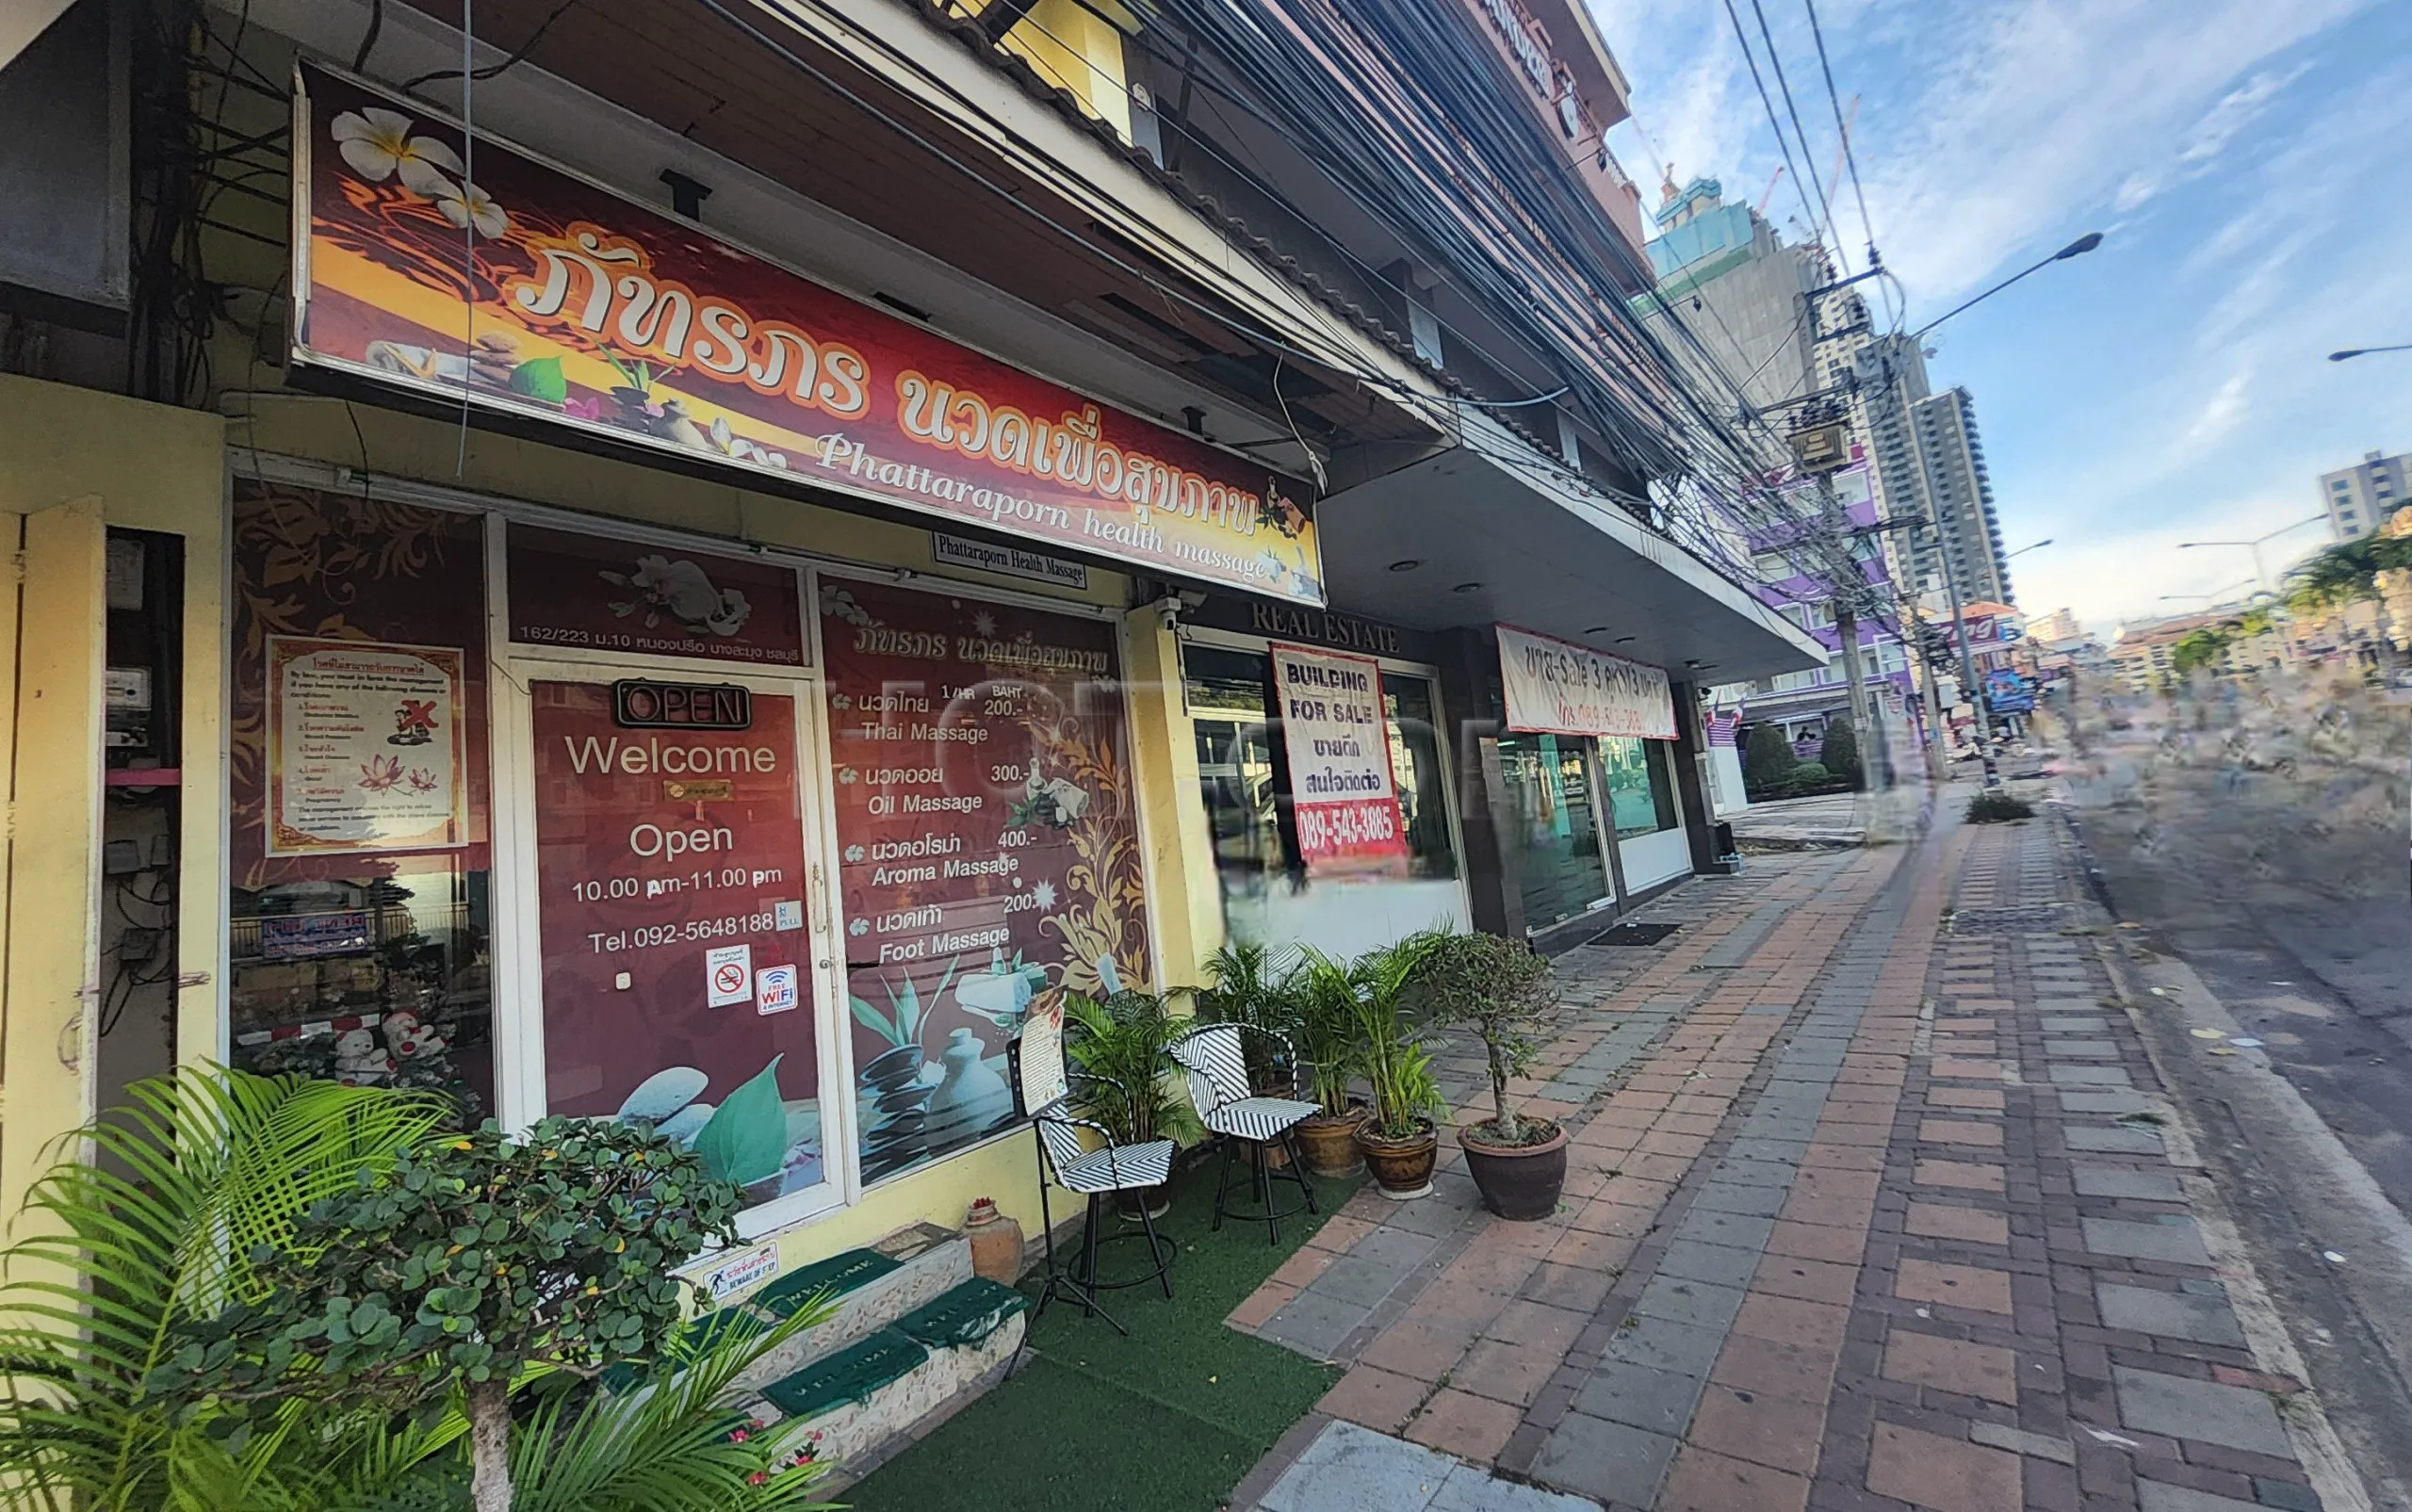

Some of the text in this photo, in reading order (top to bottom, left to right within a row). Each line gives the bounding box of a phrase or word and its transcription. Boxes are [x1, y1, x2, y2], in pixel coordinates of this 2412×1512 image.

[513, 230, 1258, 539] ภัทรภร นวดเพื่อสุขภาพ
[814, 432, 1268, 582] Phattaraporn health massage
[937, 534, 1083, 585] Phattaraporn Health Massage
[519, 626, 589, 643] 162/223
[854, 620, 947, 658] ภัทรภร
[1252, 602, 1400, 654] REAL ESTATE
[627, 686, 742, 723] OPEN
[858, 690, 1022, 716] นวดไทย 200.-
[992, 685, 1022, 700] BAHT
[1290, 699, 1374, 724] FOR SALE
[861, 722, 988, 745] Thai Massage
[564, 735, 776, 774] Welcome
[865, 765, 1030, 785] นวดออย 300.-
[1306, 766, 1381, 794] สนใจติดต่อ
[868, 794, 983, 815] Oil Massage
[629, 824, 733, 862] Open
[1298, 805, 1393, 851] 089-543-3885
[872, 830, 1037, 860] นวดอโรม่า 400.-
[872, 857, 1019, 886] Aroma Massage
[572, 877, 639, 902] 10.00
[588, 912, 774, 954] Tel.092-5648188
[876, 904, 942, 934] นวดเท้า
[879, 927, 1010, 965] Foot Massage
